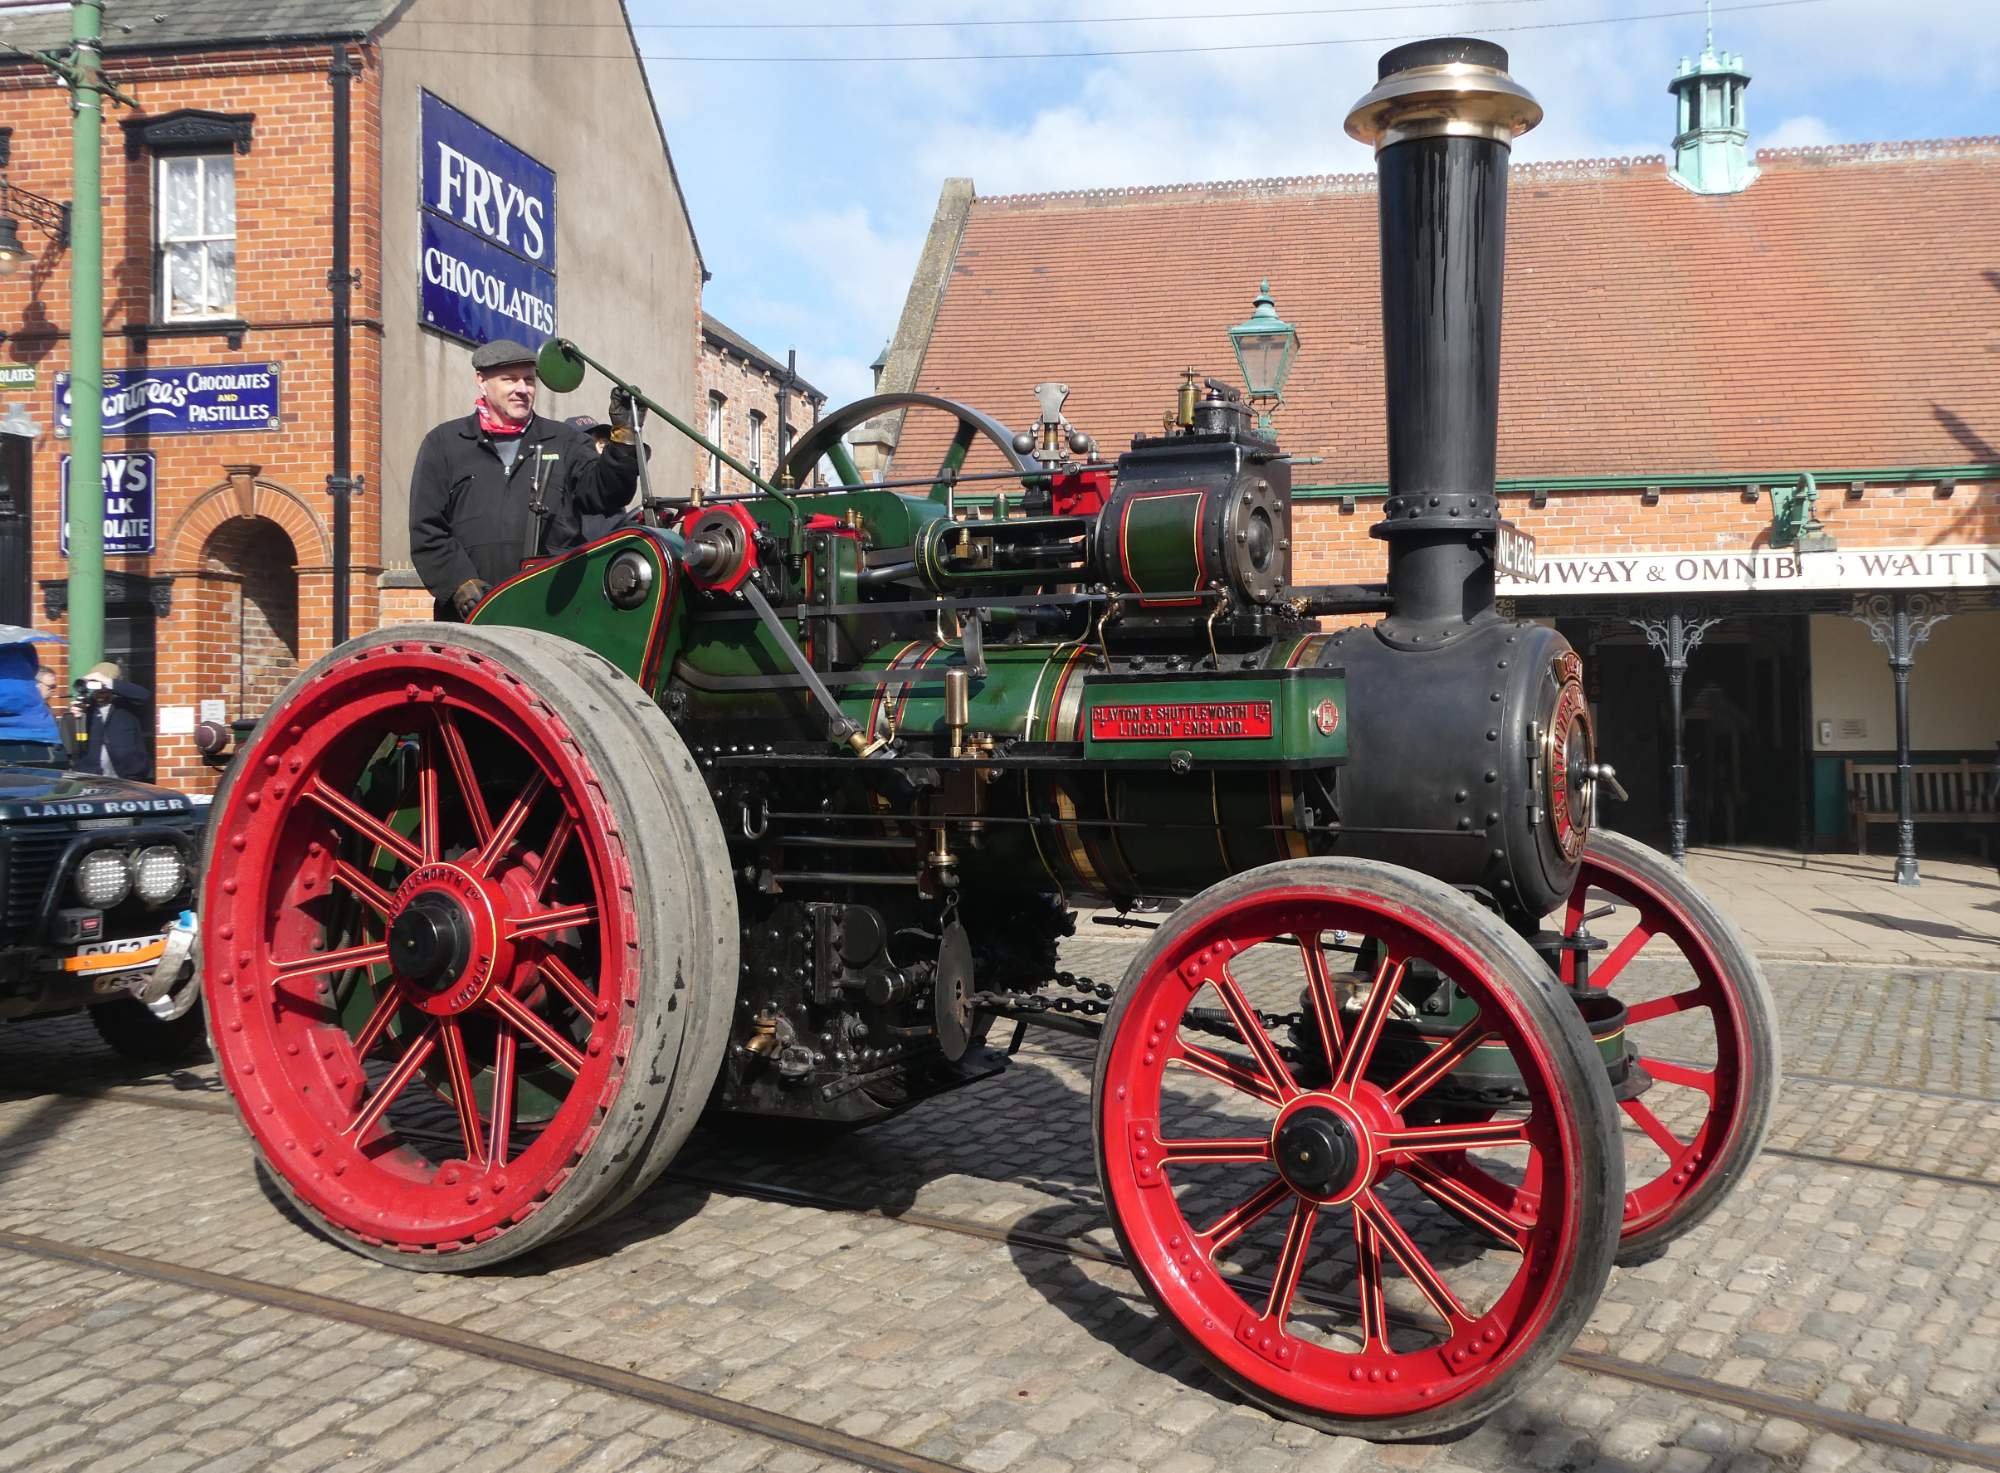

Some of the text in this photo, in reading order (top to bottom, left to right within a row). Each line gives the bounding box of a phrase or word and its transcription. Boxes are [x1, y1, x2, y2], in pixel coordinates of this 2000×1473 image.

[437, 141, 544, 259] FRY'S
[425, 247, 553, 335] CHOCOLATES
[187, 372, 270, 393] CHOCOLATES
[217, 394, 238, 402] AND
[189, 404, 270, 422] PASTILLES
[102, 456, 147, 492] Y'S
[107, 497, 134, 514] LK
[1495, 561, 1638, 584] MWAY
[1646, 566, 1666, 582] &
[1093, 707, 1140, 721] CLAYTON
[1120, 722, 1172, 736] LINCOLN
[24, 799, 184, 817] LAND ROVER
